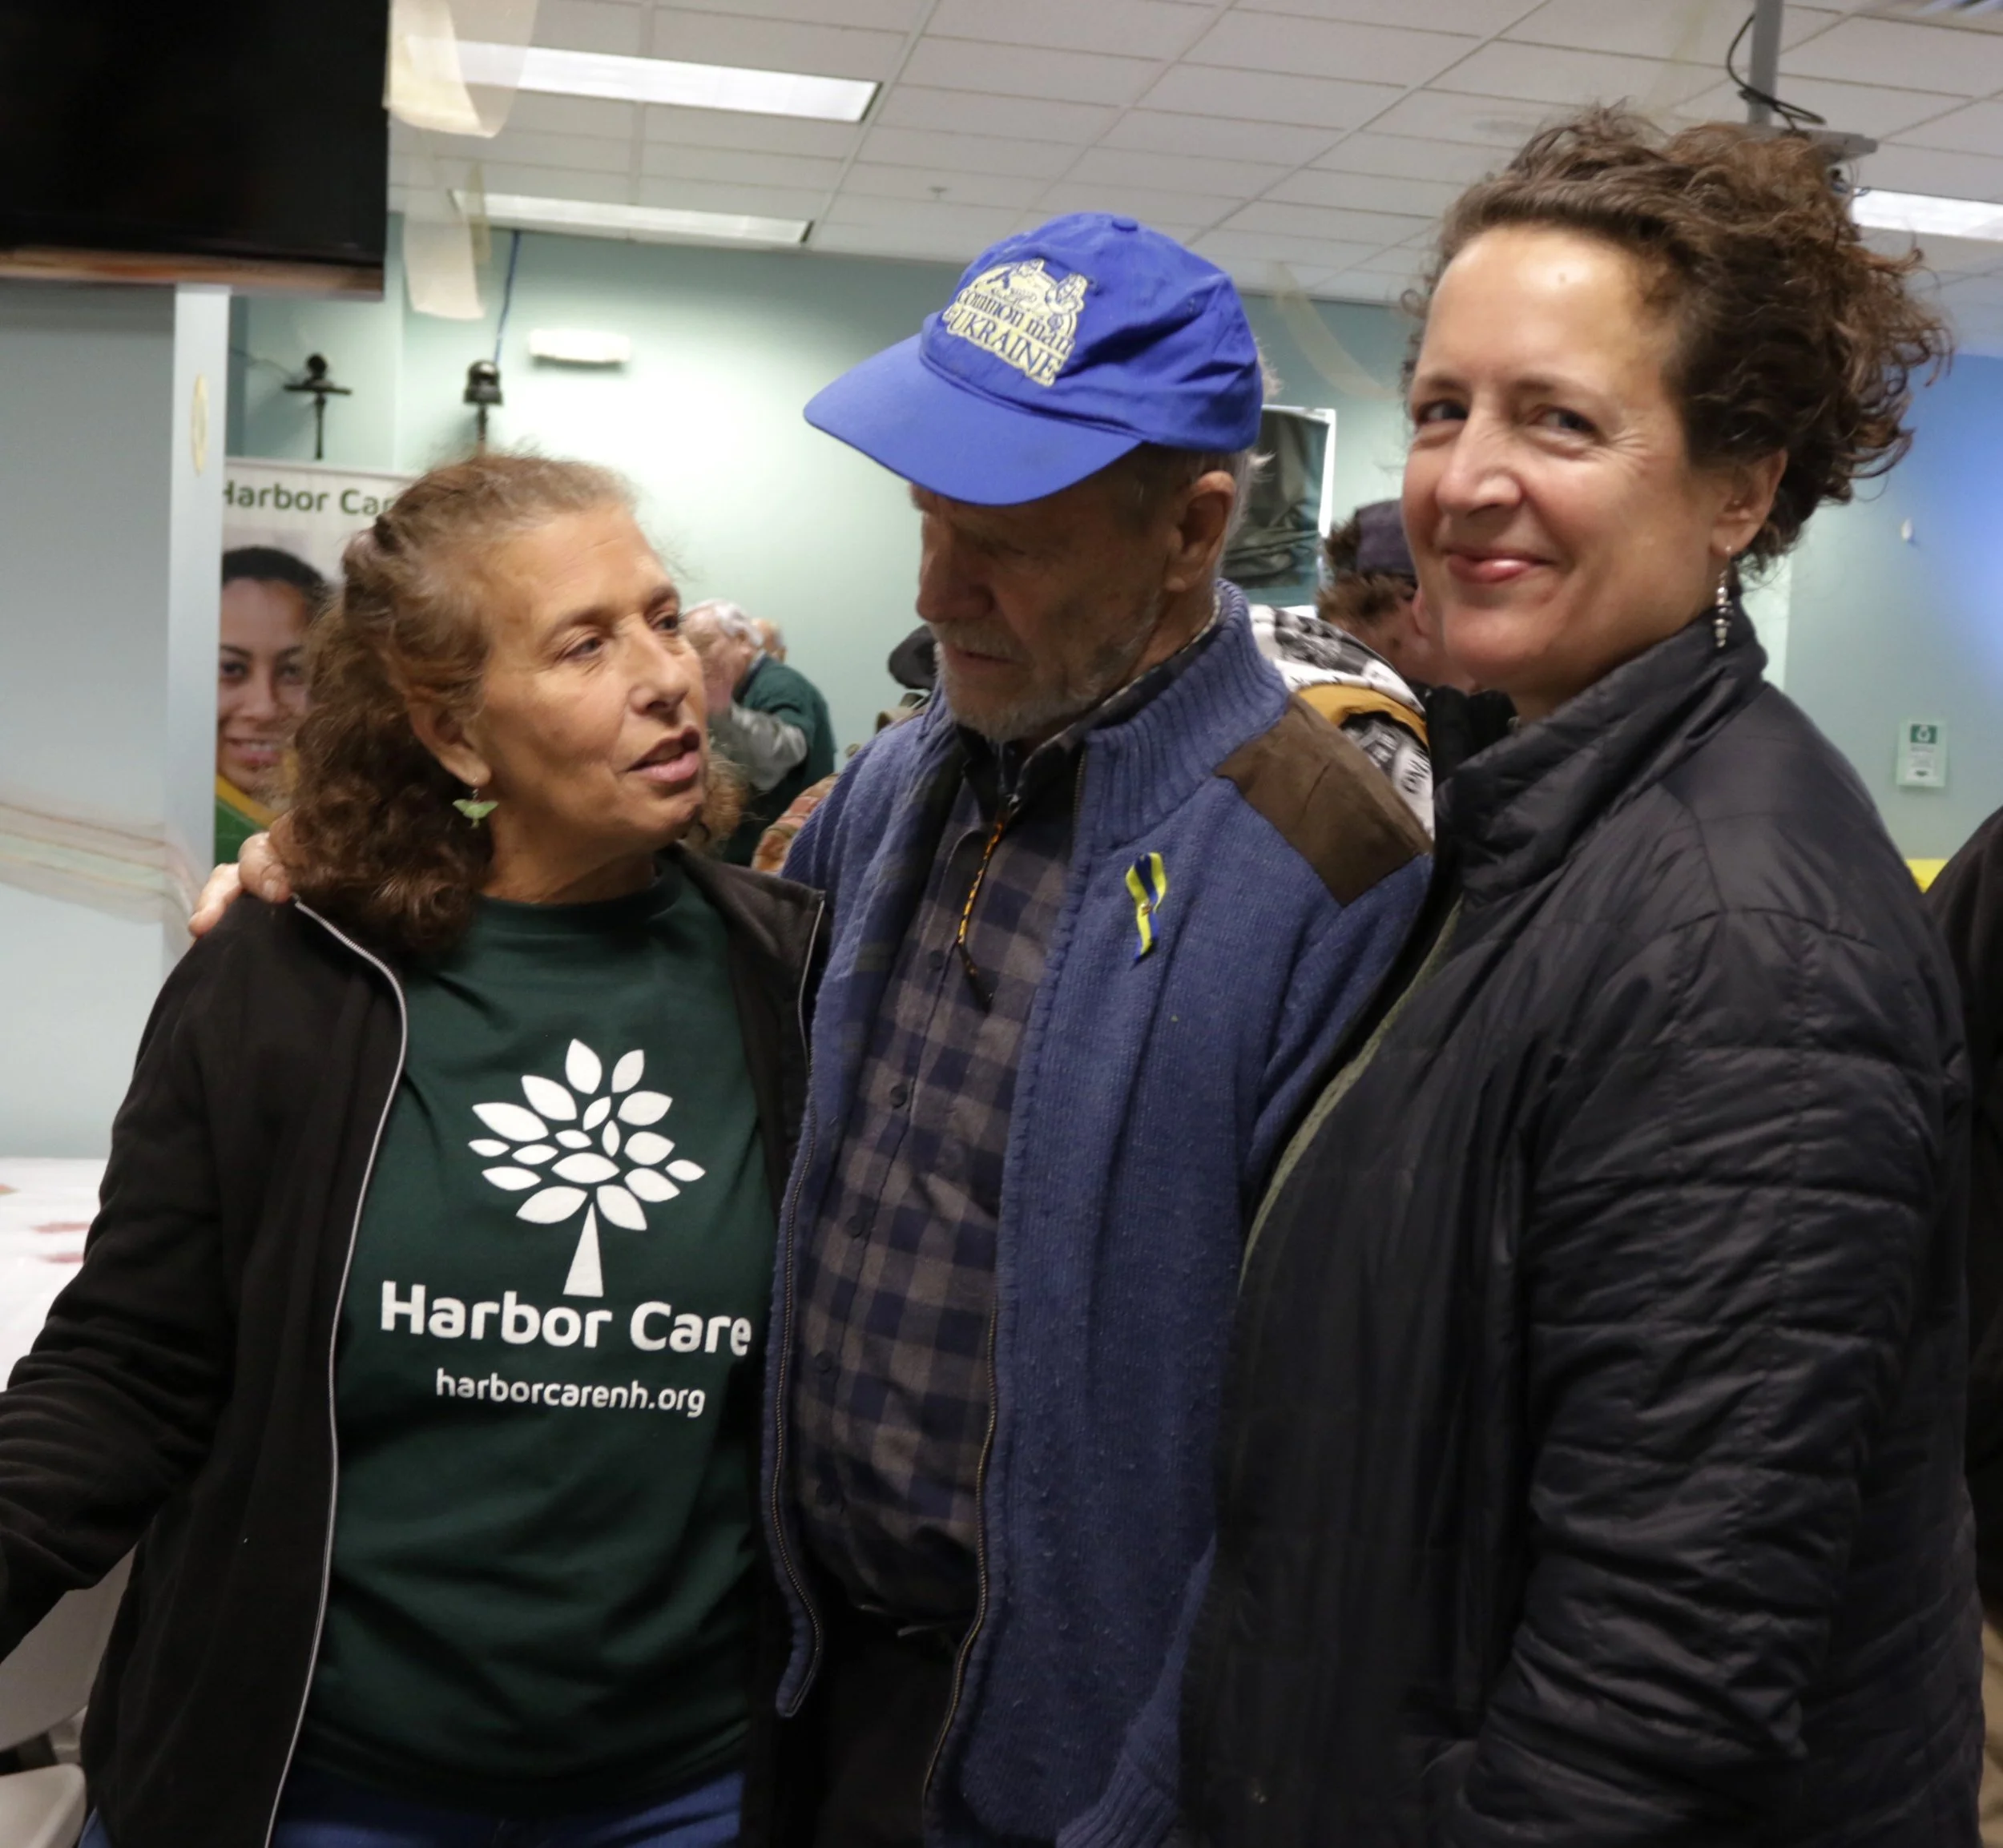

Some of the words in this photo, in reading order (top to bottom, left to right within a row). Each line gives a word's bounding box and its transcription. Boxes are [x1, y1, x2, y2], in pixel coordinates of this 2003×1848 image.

[949, 307, 1062, 380] UKRAINE
[340, 488, 395, 516] Car
[381, 1280, 612, 1348] Harbor
[630, 1301, 752, 1356] Care
[436, 1367, 706, 1418] harborcarenh.org
